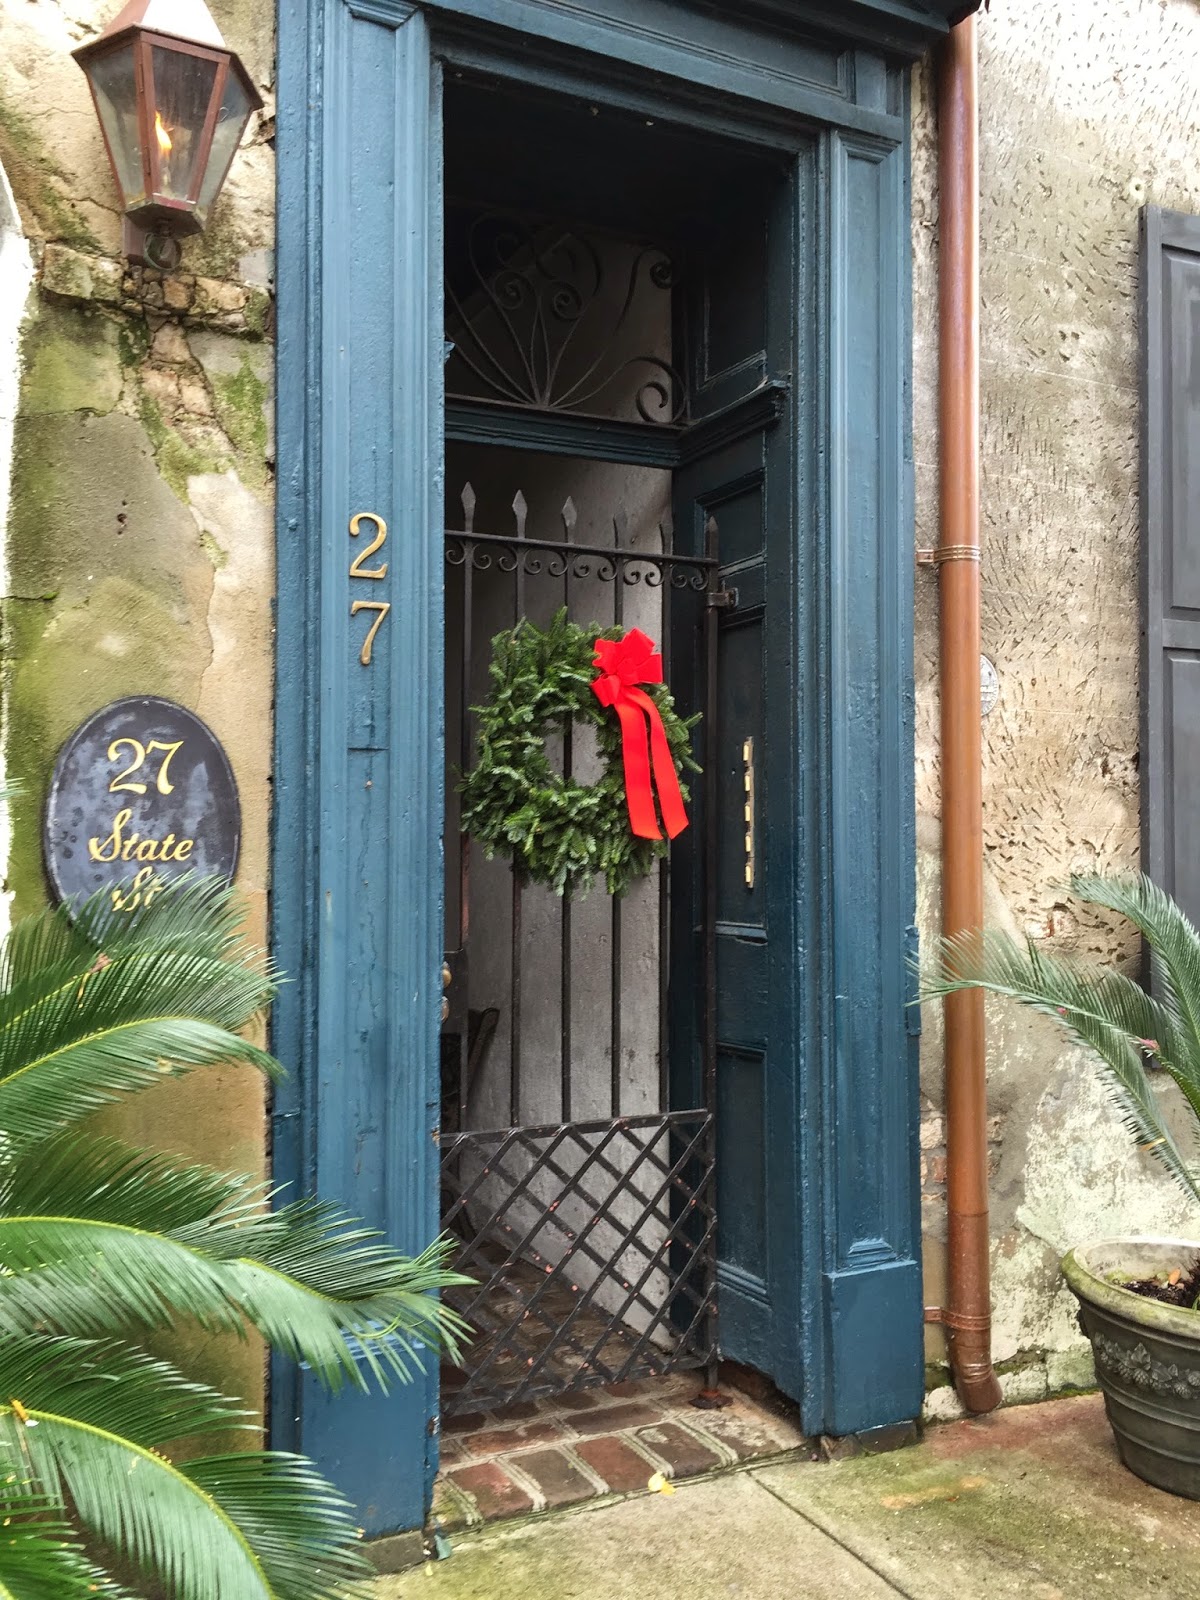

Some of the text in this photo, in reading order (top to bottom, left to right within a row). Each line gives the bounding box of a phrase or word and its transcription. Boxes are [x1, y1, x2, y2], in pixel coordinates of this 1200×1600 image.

[349, 512, 390, 665] 27
[107, 737, 184, 795] 27
[88, 808, 194, 862] State
